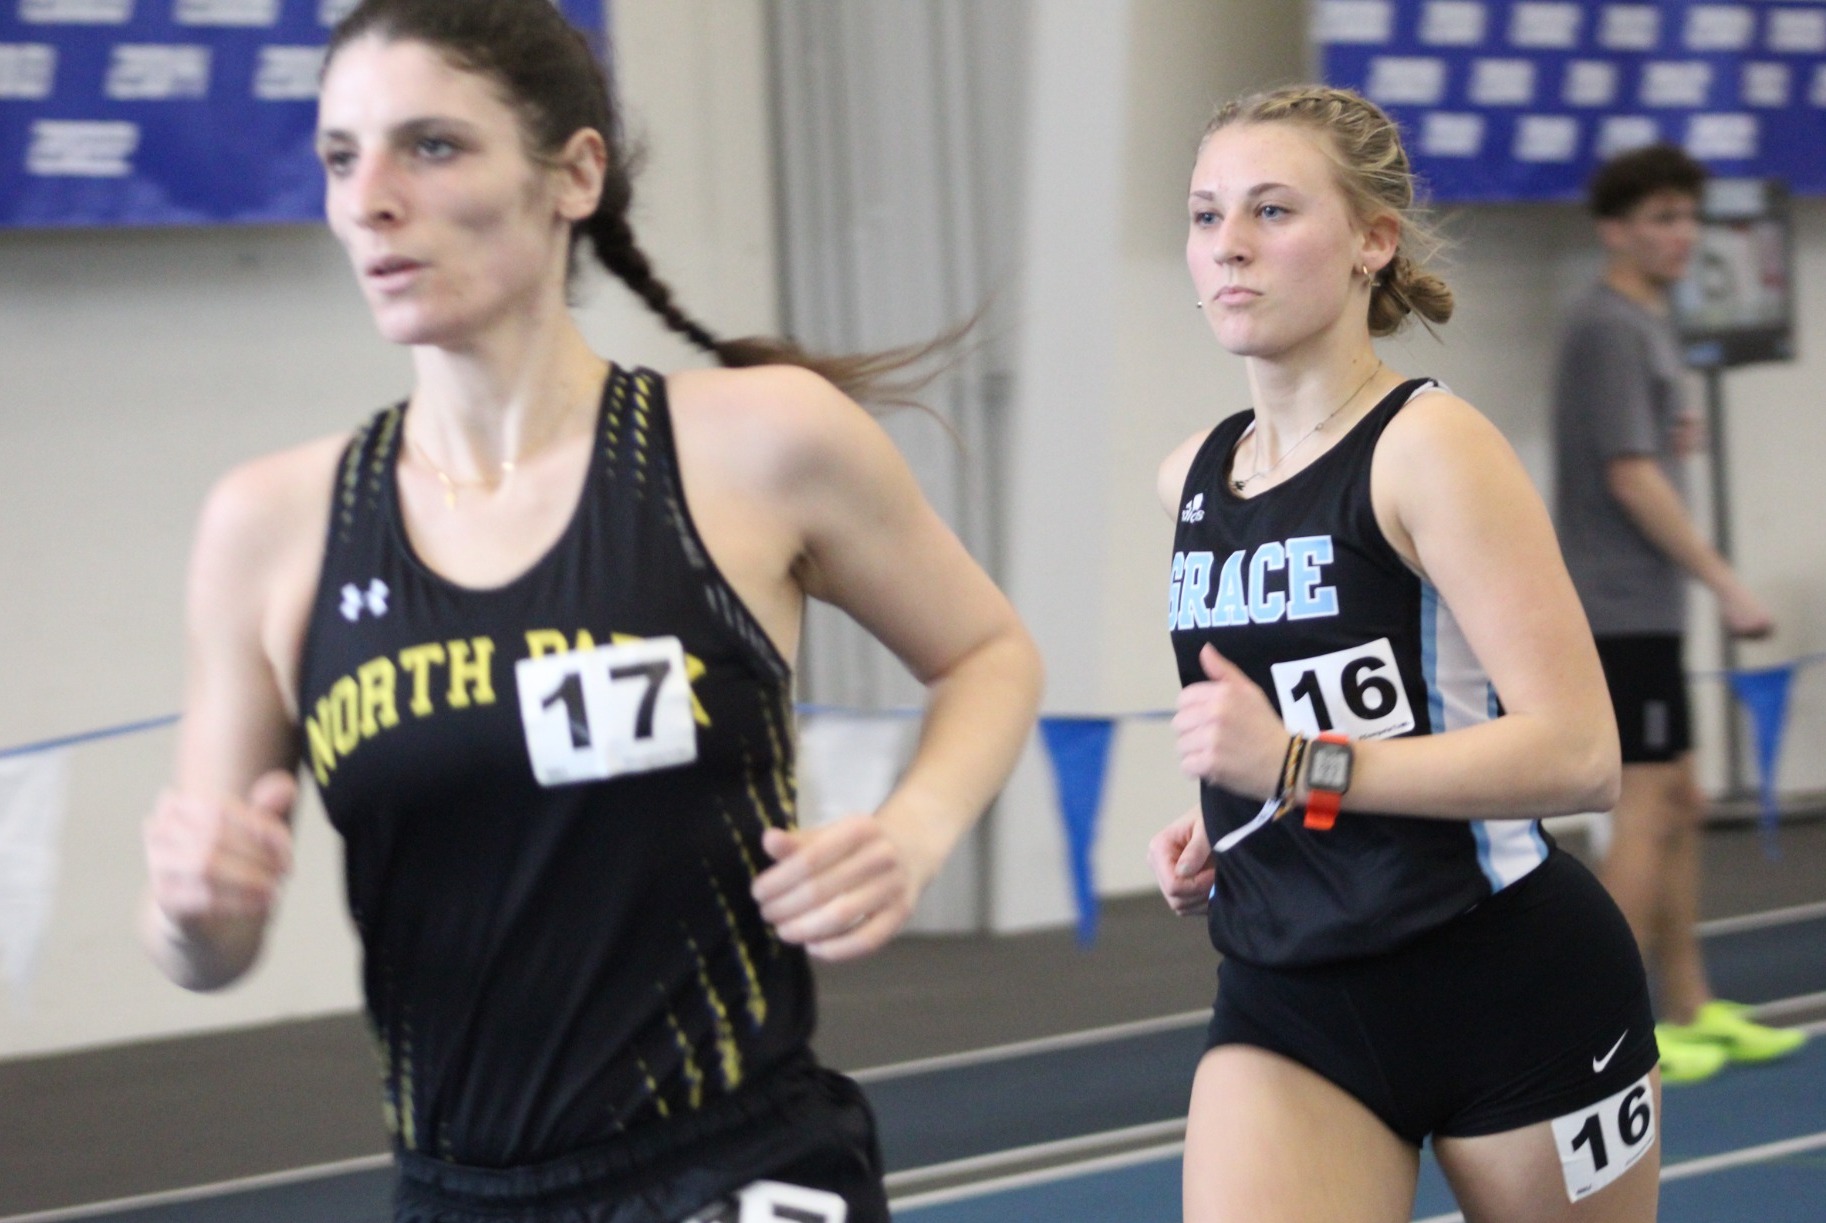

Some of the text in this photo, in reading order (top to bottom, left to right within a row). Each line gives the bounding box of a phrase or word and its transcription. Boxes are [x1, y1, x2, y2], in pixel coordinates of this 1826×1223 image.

[1168, 535, 1339, 631] GRACE
[306, 636, 496, 787] NORTH
[542, 659, 671, 749] 17
[1290, 656, 1398, 731] 16
[1571, 1086, 1650, 1172] 16
